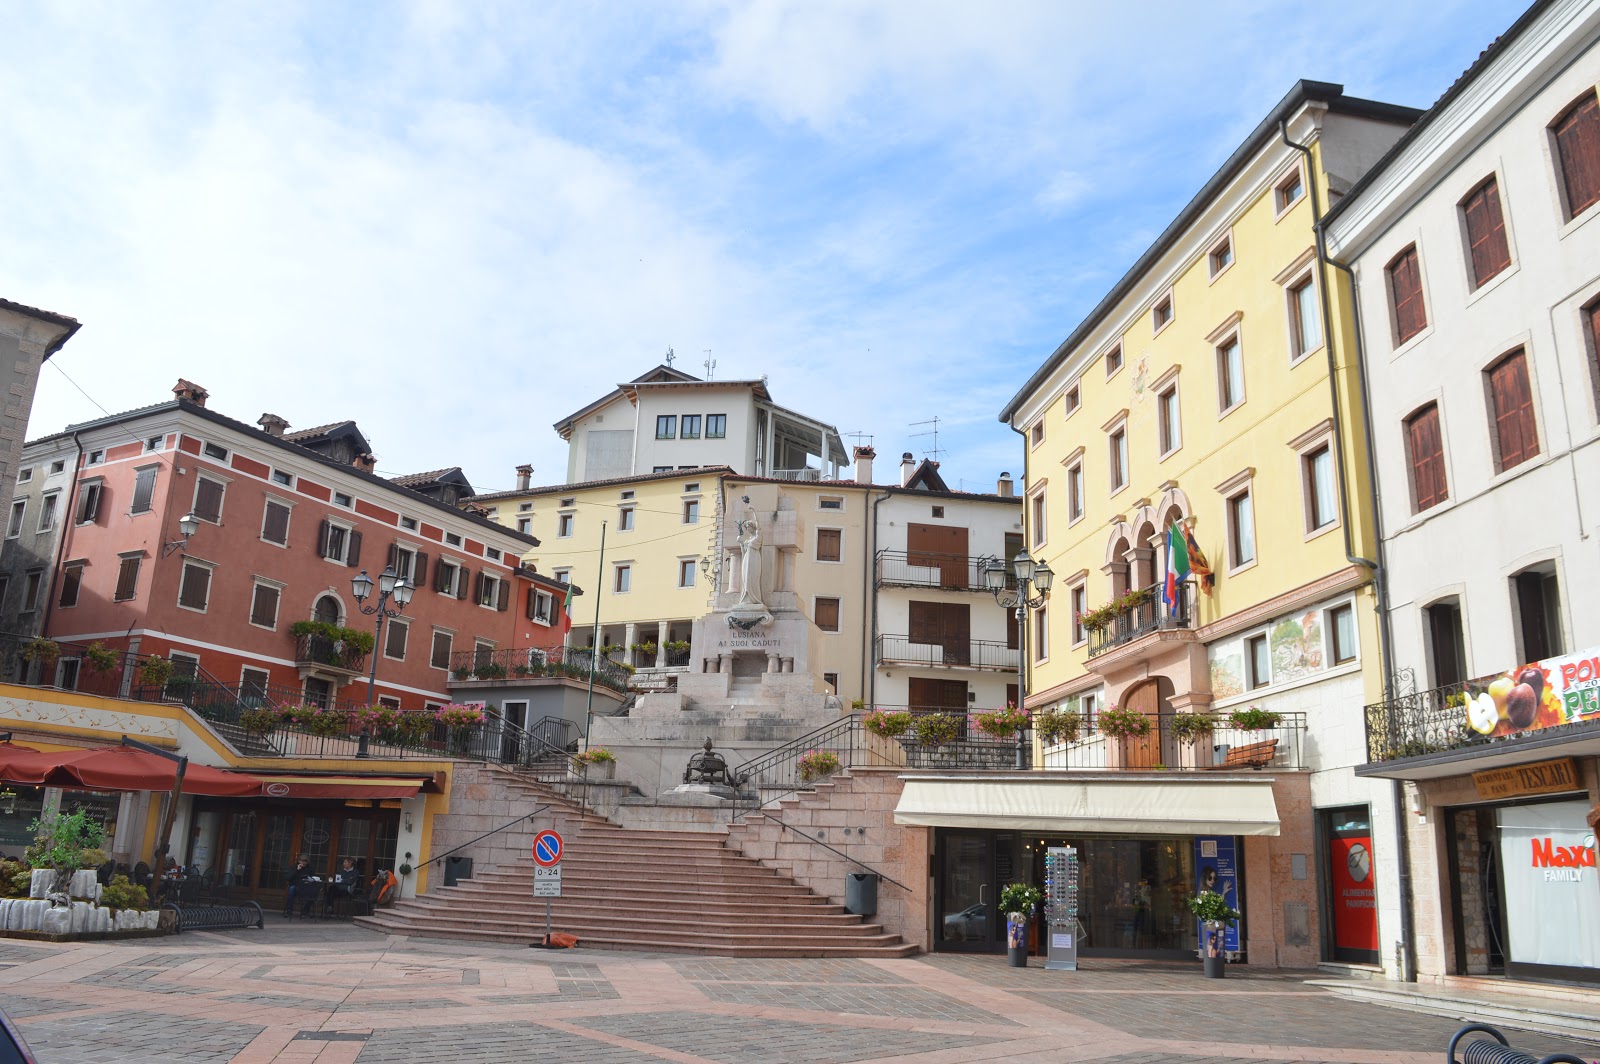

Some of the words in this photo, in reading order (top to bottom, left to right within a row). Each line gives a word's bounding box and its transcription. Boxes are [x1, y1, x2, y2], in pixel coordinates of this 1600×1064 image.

[751, 639, 780, 647] CADUTI
[1563, 686, 1600, 719] PE
[1476, 771, 1515, 784] ALIMENTARI
[1516, 762, 1573, 789] TESCARI
[1491, 783, 1507, 793] PANE
[1531, 835, 1596, 868] Maxi
[1544, 870, 1583, 882] FAMILY
